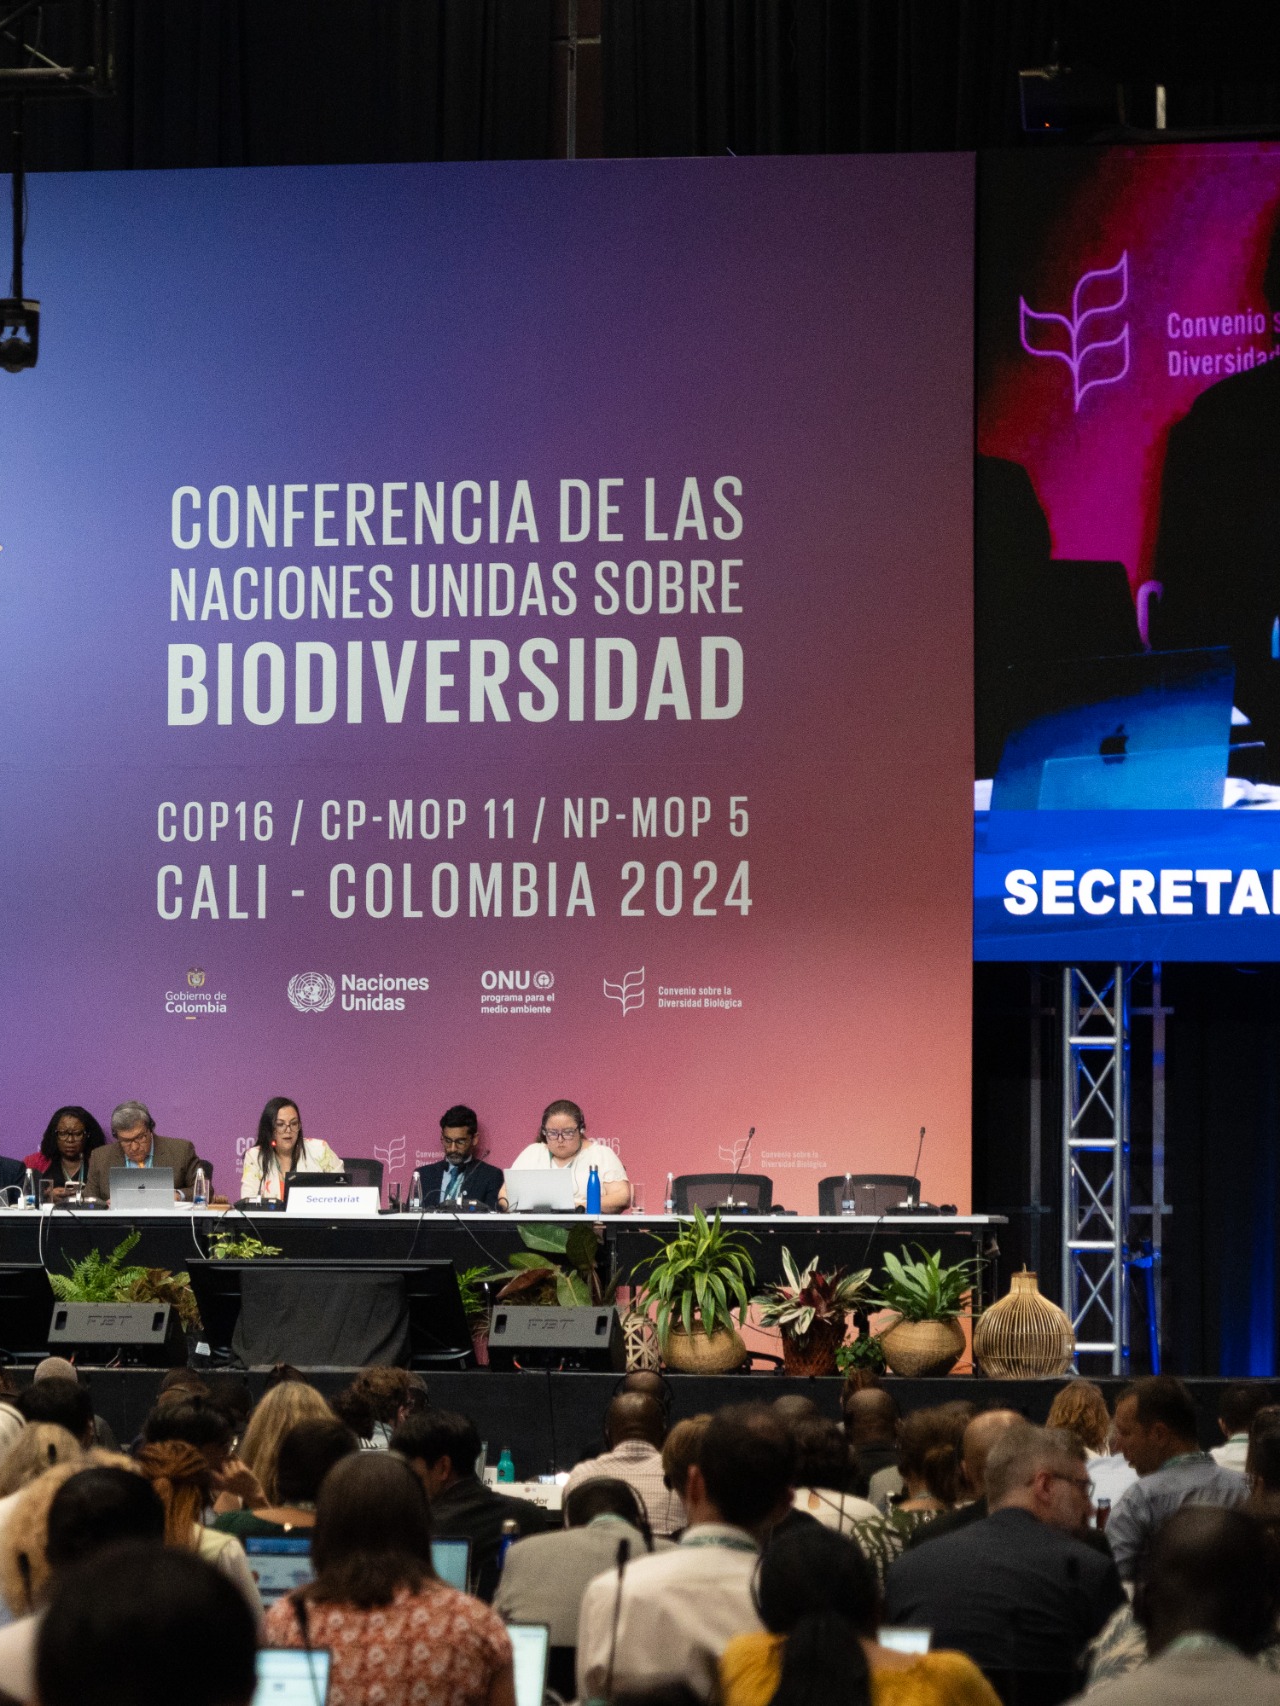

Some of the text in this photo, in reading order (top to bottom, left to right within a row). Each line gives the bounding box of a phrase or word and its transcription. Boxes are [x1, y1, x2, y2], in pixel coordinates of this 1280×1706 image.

[1167, 308, 1266, 338] Convenio
[171, 476, 743, 549] CONFERENCIA DE LAS
[170, 559, 743, 621] NACIONES UNIDAS SOBRE
[168, 636, 744, 726] BIODIVERSIDAD
[157, 800, 274, 842] COP16
[321, 798, 466, 840] CP-MOP
[484, 798, 515, 839] 11
[563, 796, 711, 838] NP-MOP
[730, 796, 749, 837] 5
[157, 864, 266, 920] CALI
[329, 861, 596, 919] COLOMBIA
[620, 860, 753, 917] 2024
[341, 974, 429, 991] Naciones
[481, 970, 530, 990] ONU
[165, 991, 227, 1001] Gobierno de
[481, 993, 555, 1004] programa para el
[658, 986, 732, 996] Convenio sobre la
[165, 1002, 227, 1013] Colombia
[341, 994, 406, 1011] Unidas
[481, 1005, 551, 1014] medio ambiente
[658, 998, 742, 1009] Diversidad Biológica
[306, 1195, 360, 1203] Secretariat
